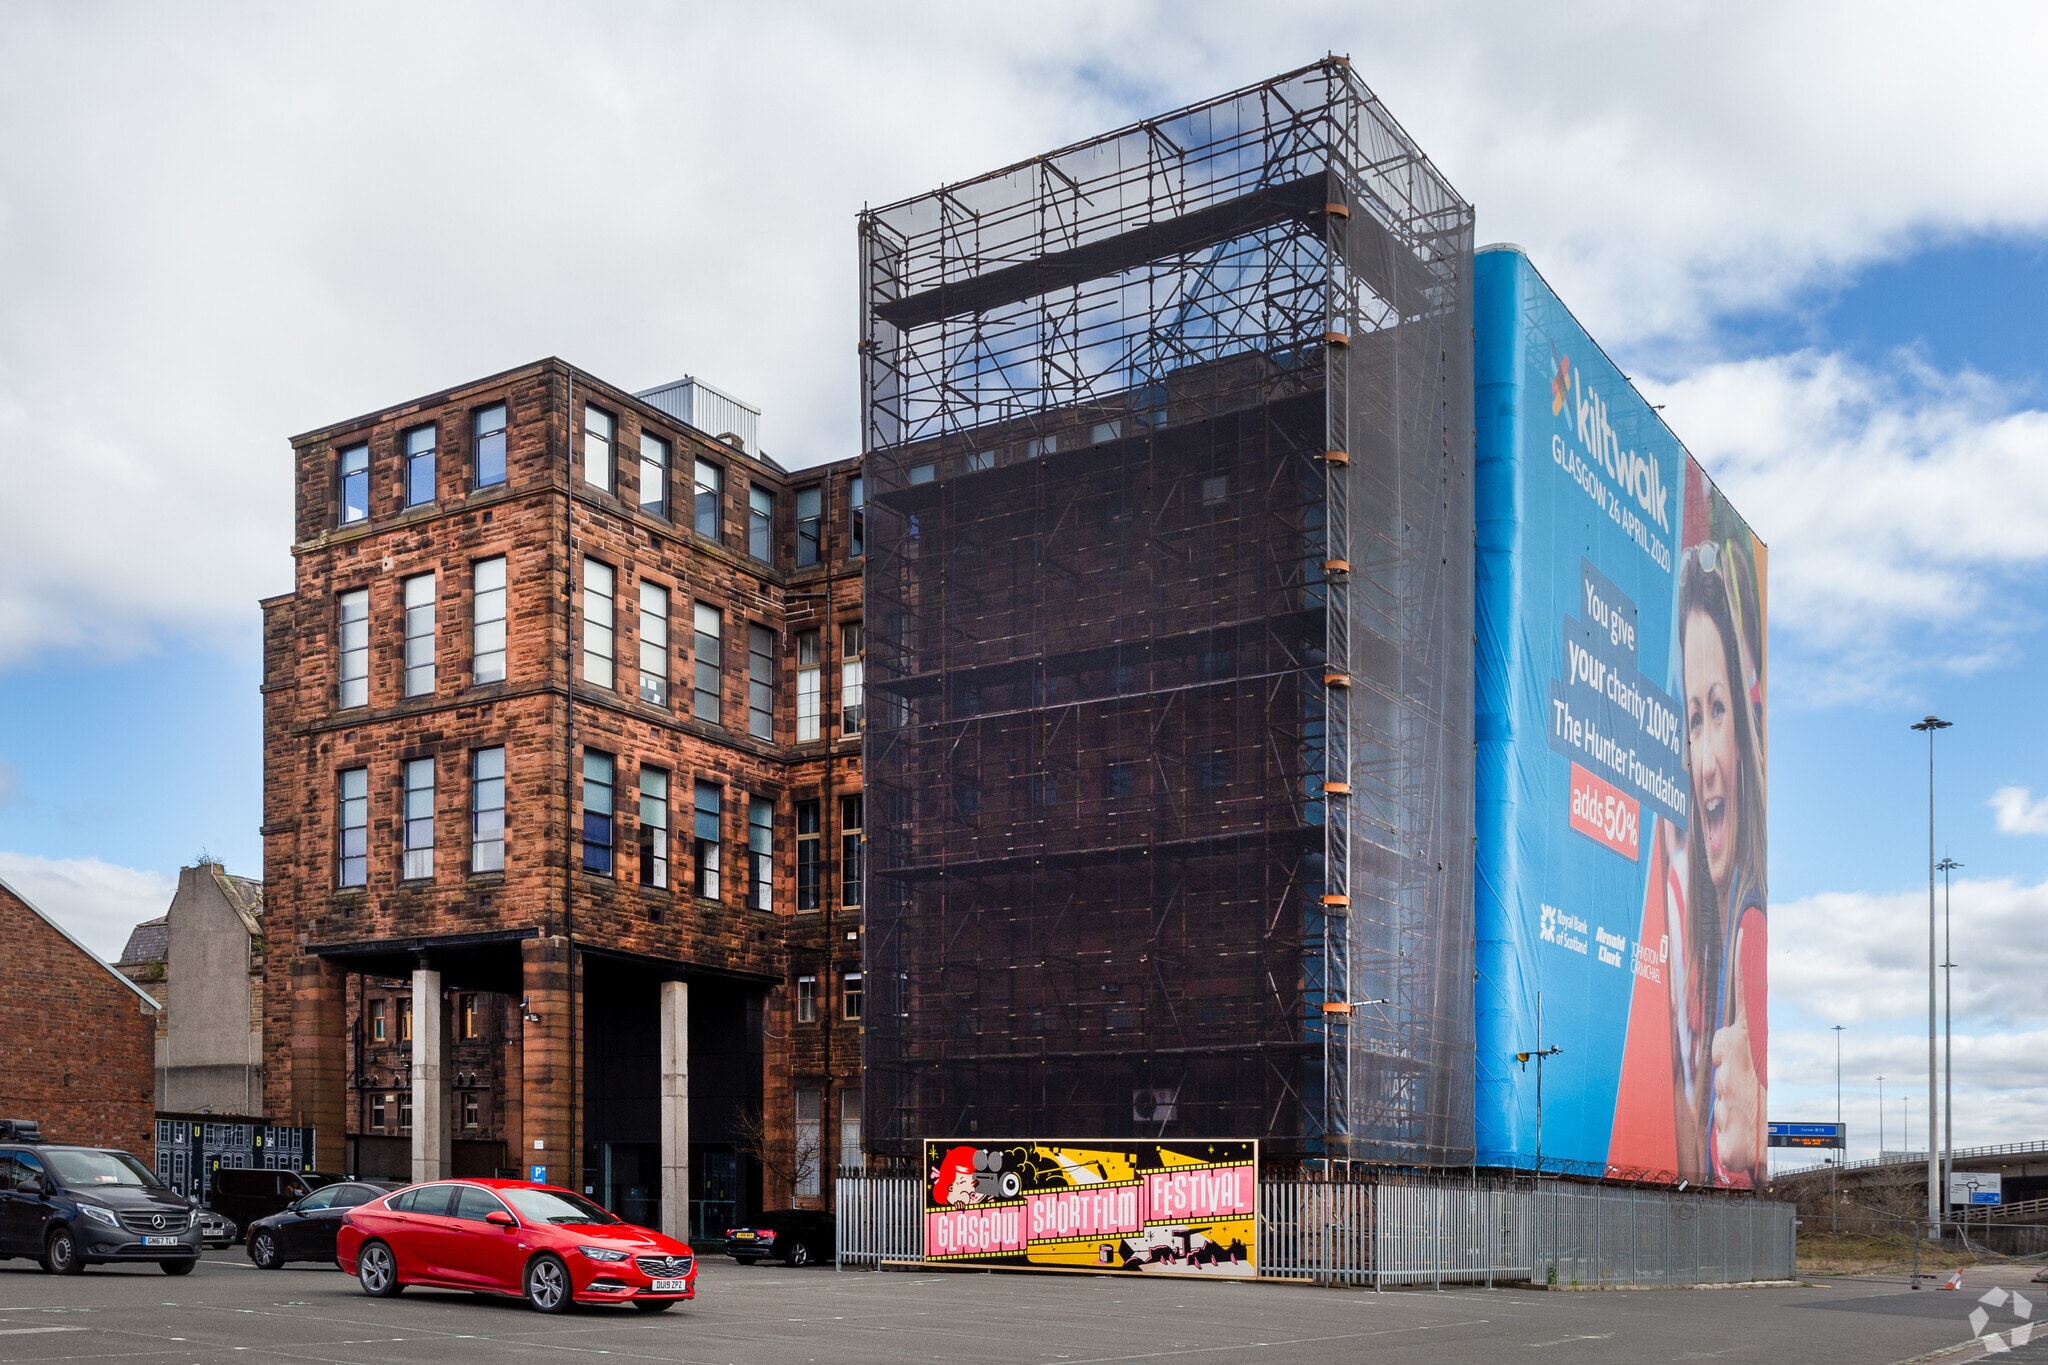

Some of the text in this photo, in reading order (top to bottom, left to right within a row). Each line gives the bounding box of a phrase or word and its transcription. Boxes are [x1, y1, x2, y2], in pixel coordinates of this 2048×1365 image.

[1574, 367, 1669, 534] kiltwalk
[1551, 434, 1671, 574] GLASGOW 26 APRIL 2020
[1584, 579, 1635, 651] You give
[1569, 639, 1680, 755] your charity 100%
[1553, 699, 1686, 817] The Hunter Foundation
[1573, 785, 1638, 847] adds 50%
[1556, 931, 1588, 955] of Scotland
[1557, 909, 1588, 935] Royal Bank
[1595, 926, 1626, 952] Arnold
[1598, 945, 1622, 969] Clark
[1630, 941, 1659, 966] JOHNSTON
[1630, 958, 1662, 984] CARMICHAEL
[937, 1171, 1244, 1252] GLASGOW SHORT FILM FESTIVAL
